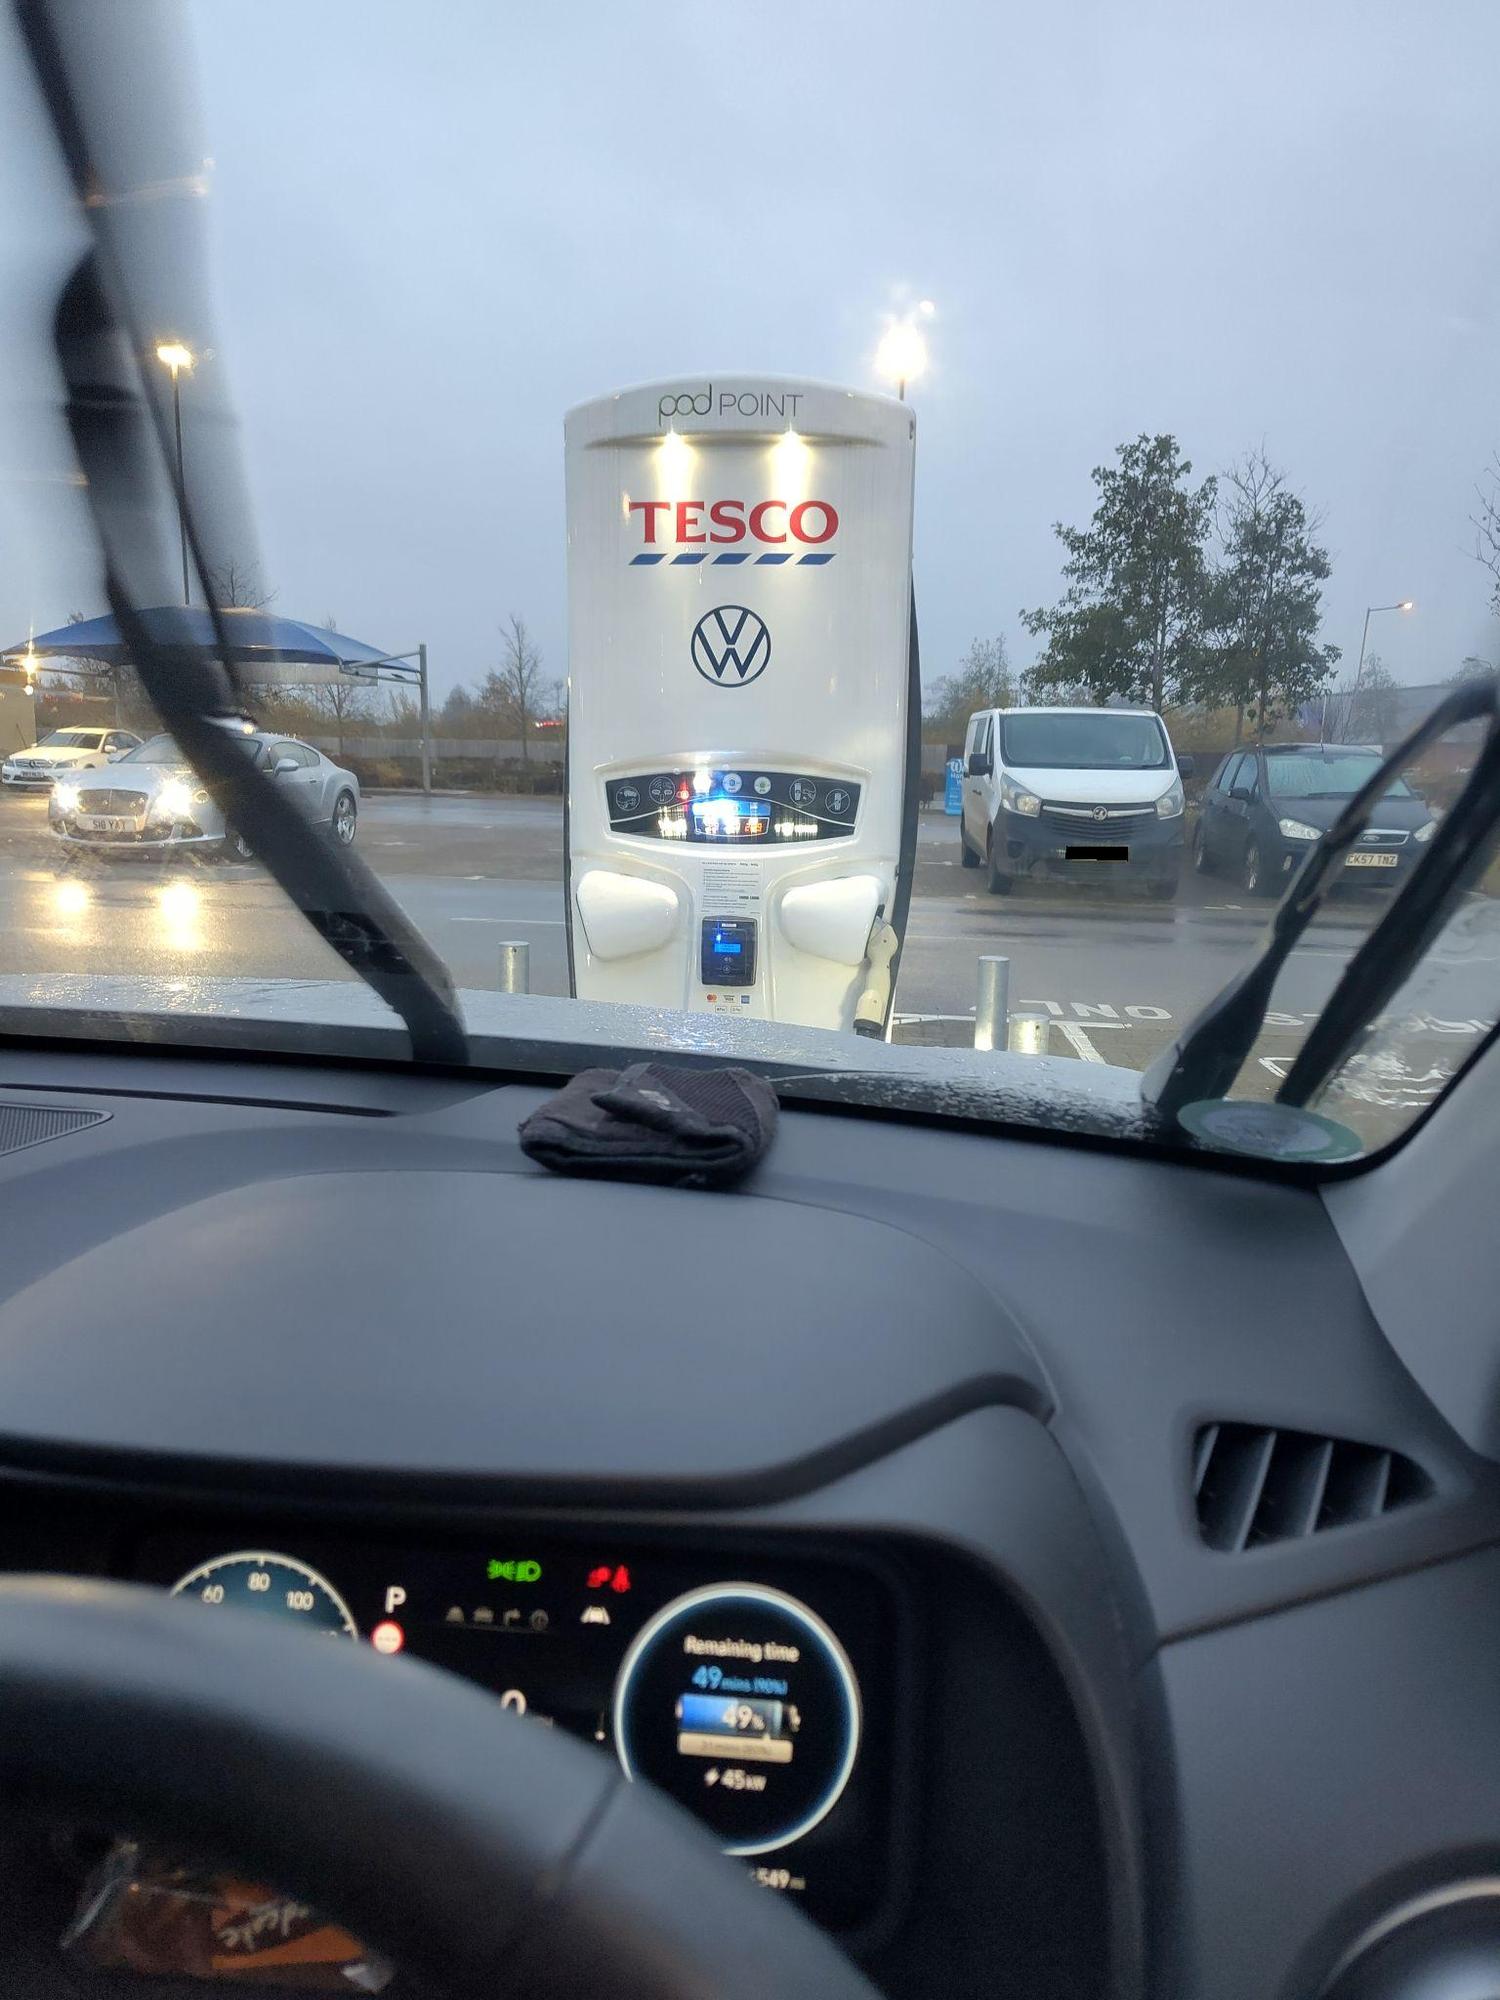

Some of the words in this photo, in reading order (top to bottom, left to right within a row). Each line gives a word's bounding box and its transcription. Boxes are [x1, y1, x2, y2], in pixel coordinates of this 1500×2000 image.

[719, 393, 804, 417] POINT
[628, 500, 840, 544] TESCO
[968, 999, 1173, 1020] ONL
[248, 1572, 271, 1592] 80
[202, 1585, 224, 1604] 60
[286, 1591, 314, 1612] 100
[385, 1586, 407, 1614] P
[684, 1635, 762, 1663] Remaining
[764, 1641, 800, 1663] time
[692, 1665, 722, 1690] 49
